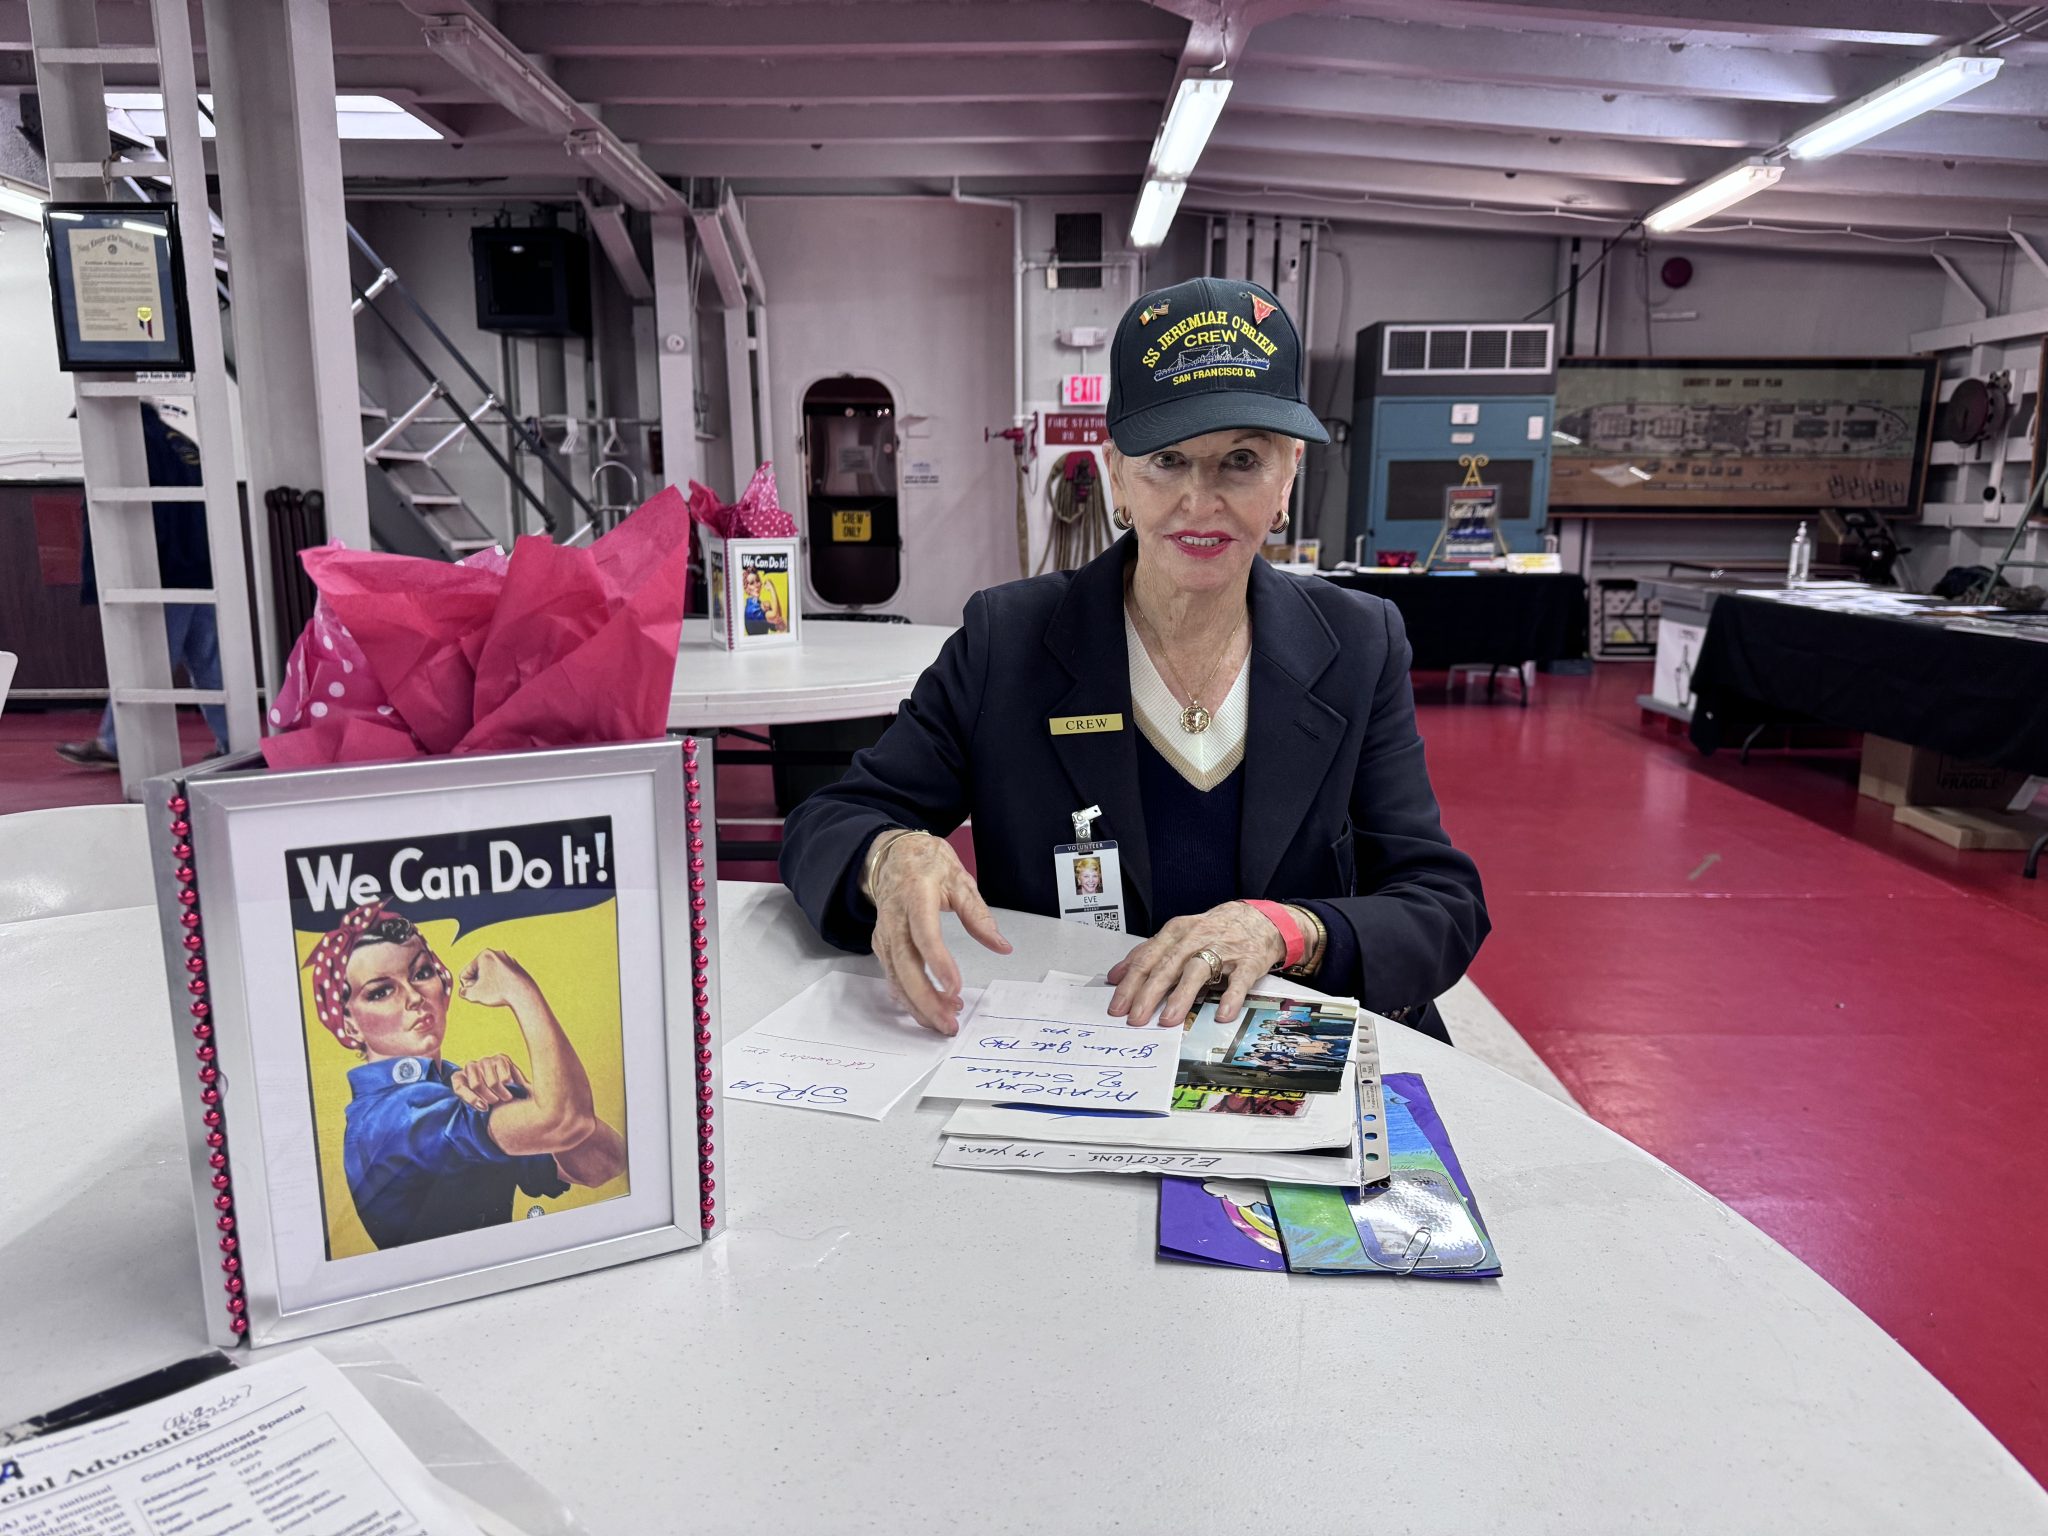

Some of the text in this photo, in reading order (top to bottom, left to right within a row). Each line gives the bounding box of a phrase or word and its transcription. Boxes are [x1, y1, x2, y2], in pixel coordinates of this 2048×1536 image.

[1142, 310, 1278, 369] SS JEREMIAH O'BRIEN
[1184, 329, 1237, 347] CREW
[1172, 367, 1256, 386] SAN FRANCISCO CA
[1070, 376, 1102, 402] EXIT
[1047, 418, 1069, 428] FIRE
[841, 513, 864, 525] CREW
[843, 526, 861, 538] ONLY
[742, 555, 788, 568] We Can Do It!
[1065, 717, 1108, 731] CREW
[1067, 842, 1104, 851] VOLUNTEER
[297, 832, 609, 912] We Can Do It!
[1083, 896, 1098, 904] EVE
[729, 1080, 848, 1104] SPCA
[1088, 1152, 1222, 1168] ELECTIONS
[65, 1421, 211, 1484] Advocates
[141, 1462, 182, 1483] Court
[185, 1430, 256, 1465] Appointed
[257, 1405, 306, 1431] Special
[196, 1434, 268, 1470] Advocates
